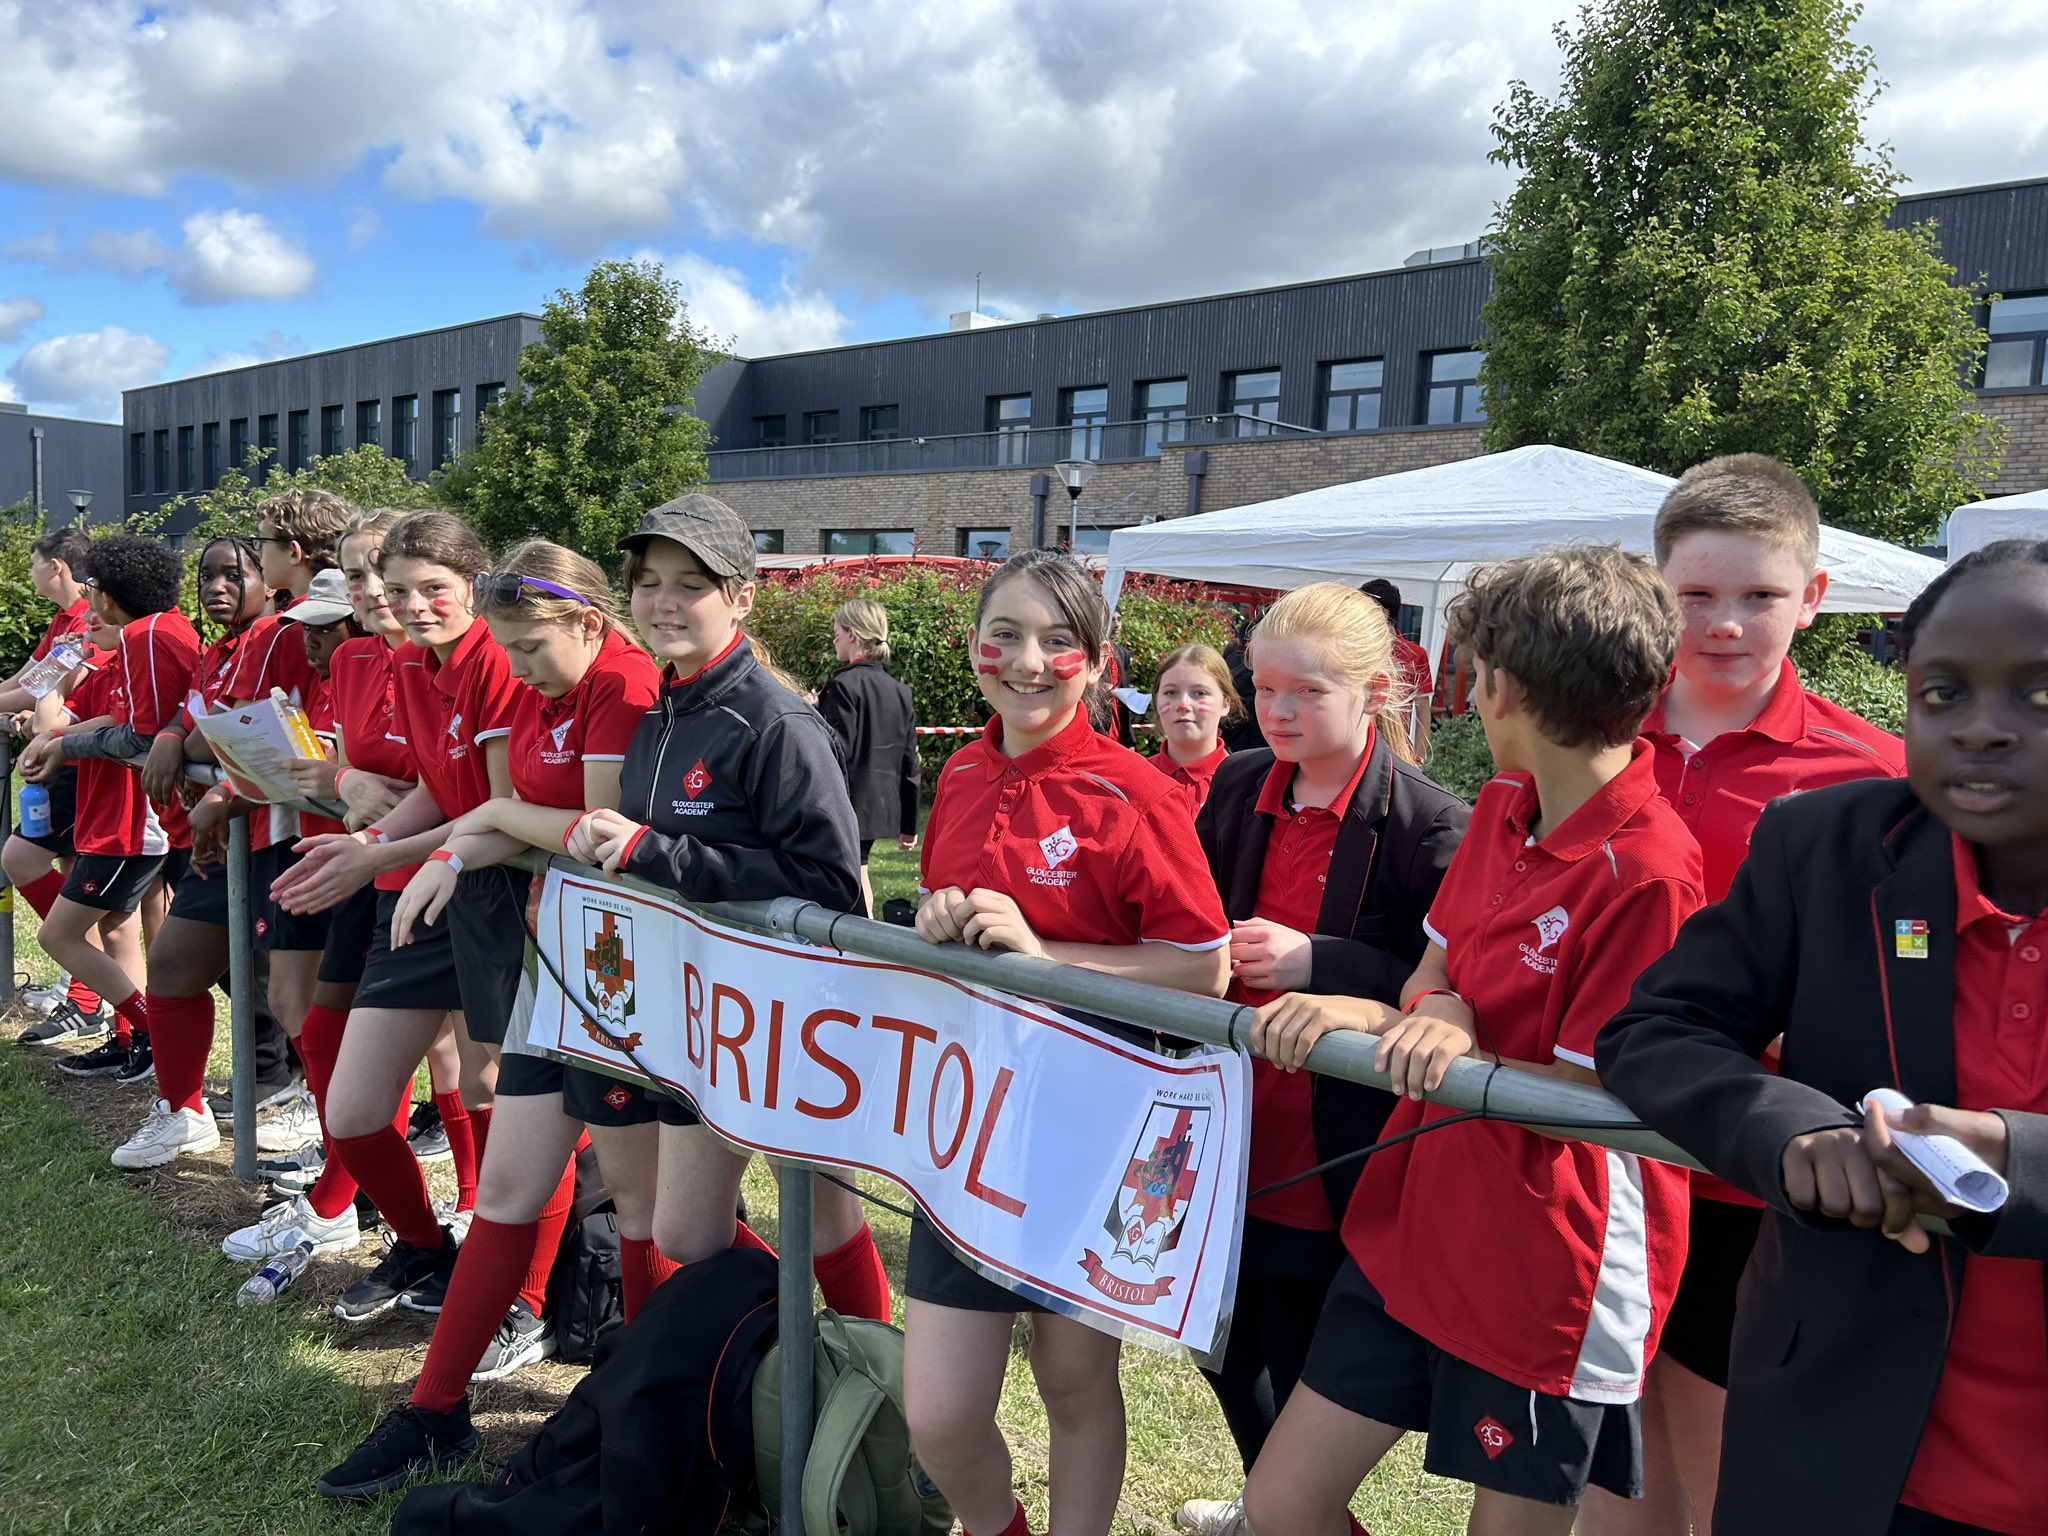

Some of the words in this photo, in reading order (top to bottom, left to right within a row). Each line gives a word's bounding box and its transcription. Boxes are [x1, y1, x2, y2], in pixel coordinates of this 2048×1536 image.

[672, 800, 715, 809] GLOUCESTER
[674, 807, 709, 816] ACADEMY
[1026, 866, 1077, 878] GLOUCESTER
[1030, 875, 1071, 886] ACADEMY
[582, 895, 598, 905] WORK
[599, 900, 612, 908] HARD
[1521, 955, 1556, 975] ACADEM
[683, 961, 1027, 1219] BRISTOL
[1156, 1089, 1178, 1099] WORK
[1179, 1092, 1194, 1101] HARD
[1099, 1273, 1146, 1301] BRISTOL
